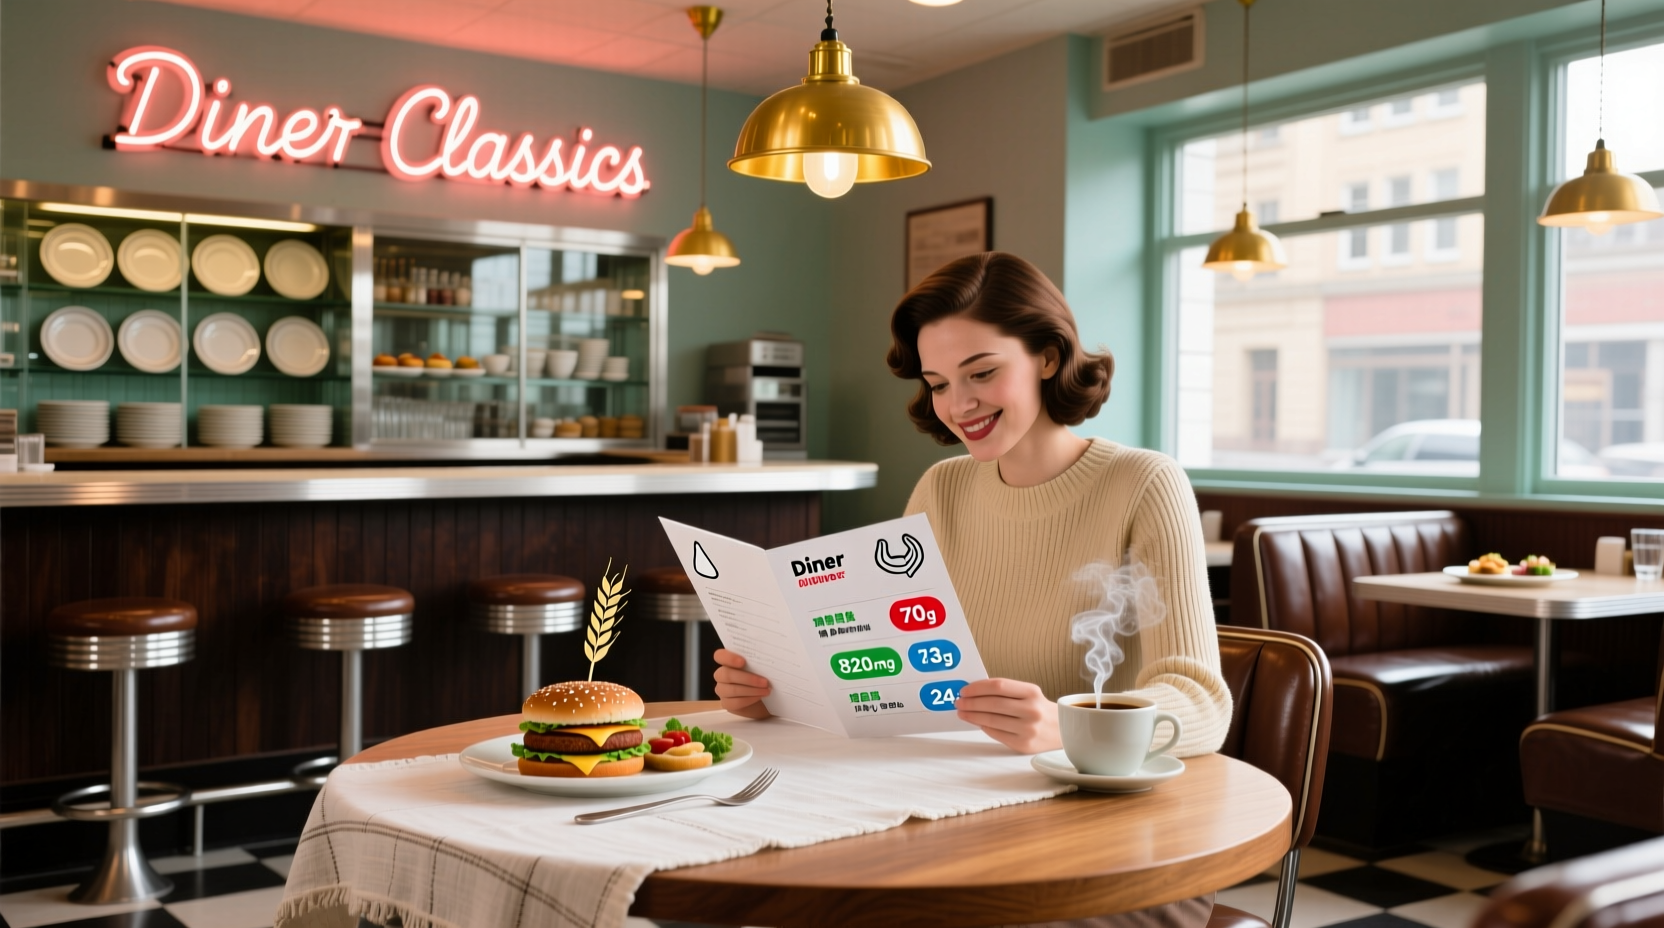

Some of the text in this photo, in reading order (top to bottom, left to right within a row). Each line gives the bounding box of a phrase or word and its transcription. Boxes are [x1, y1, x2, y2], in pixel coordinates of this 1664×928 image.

[109, 47, 651, 197] Diner Classics
[791, 554, 845, 577] Diner
[899, 604, 937, 625] 70g
[838, 656, 896, 674] 820mg
[930, 688, 961, 705] 24
